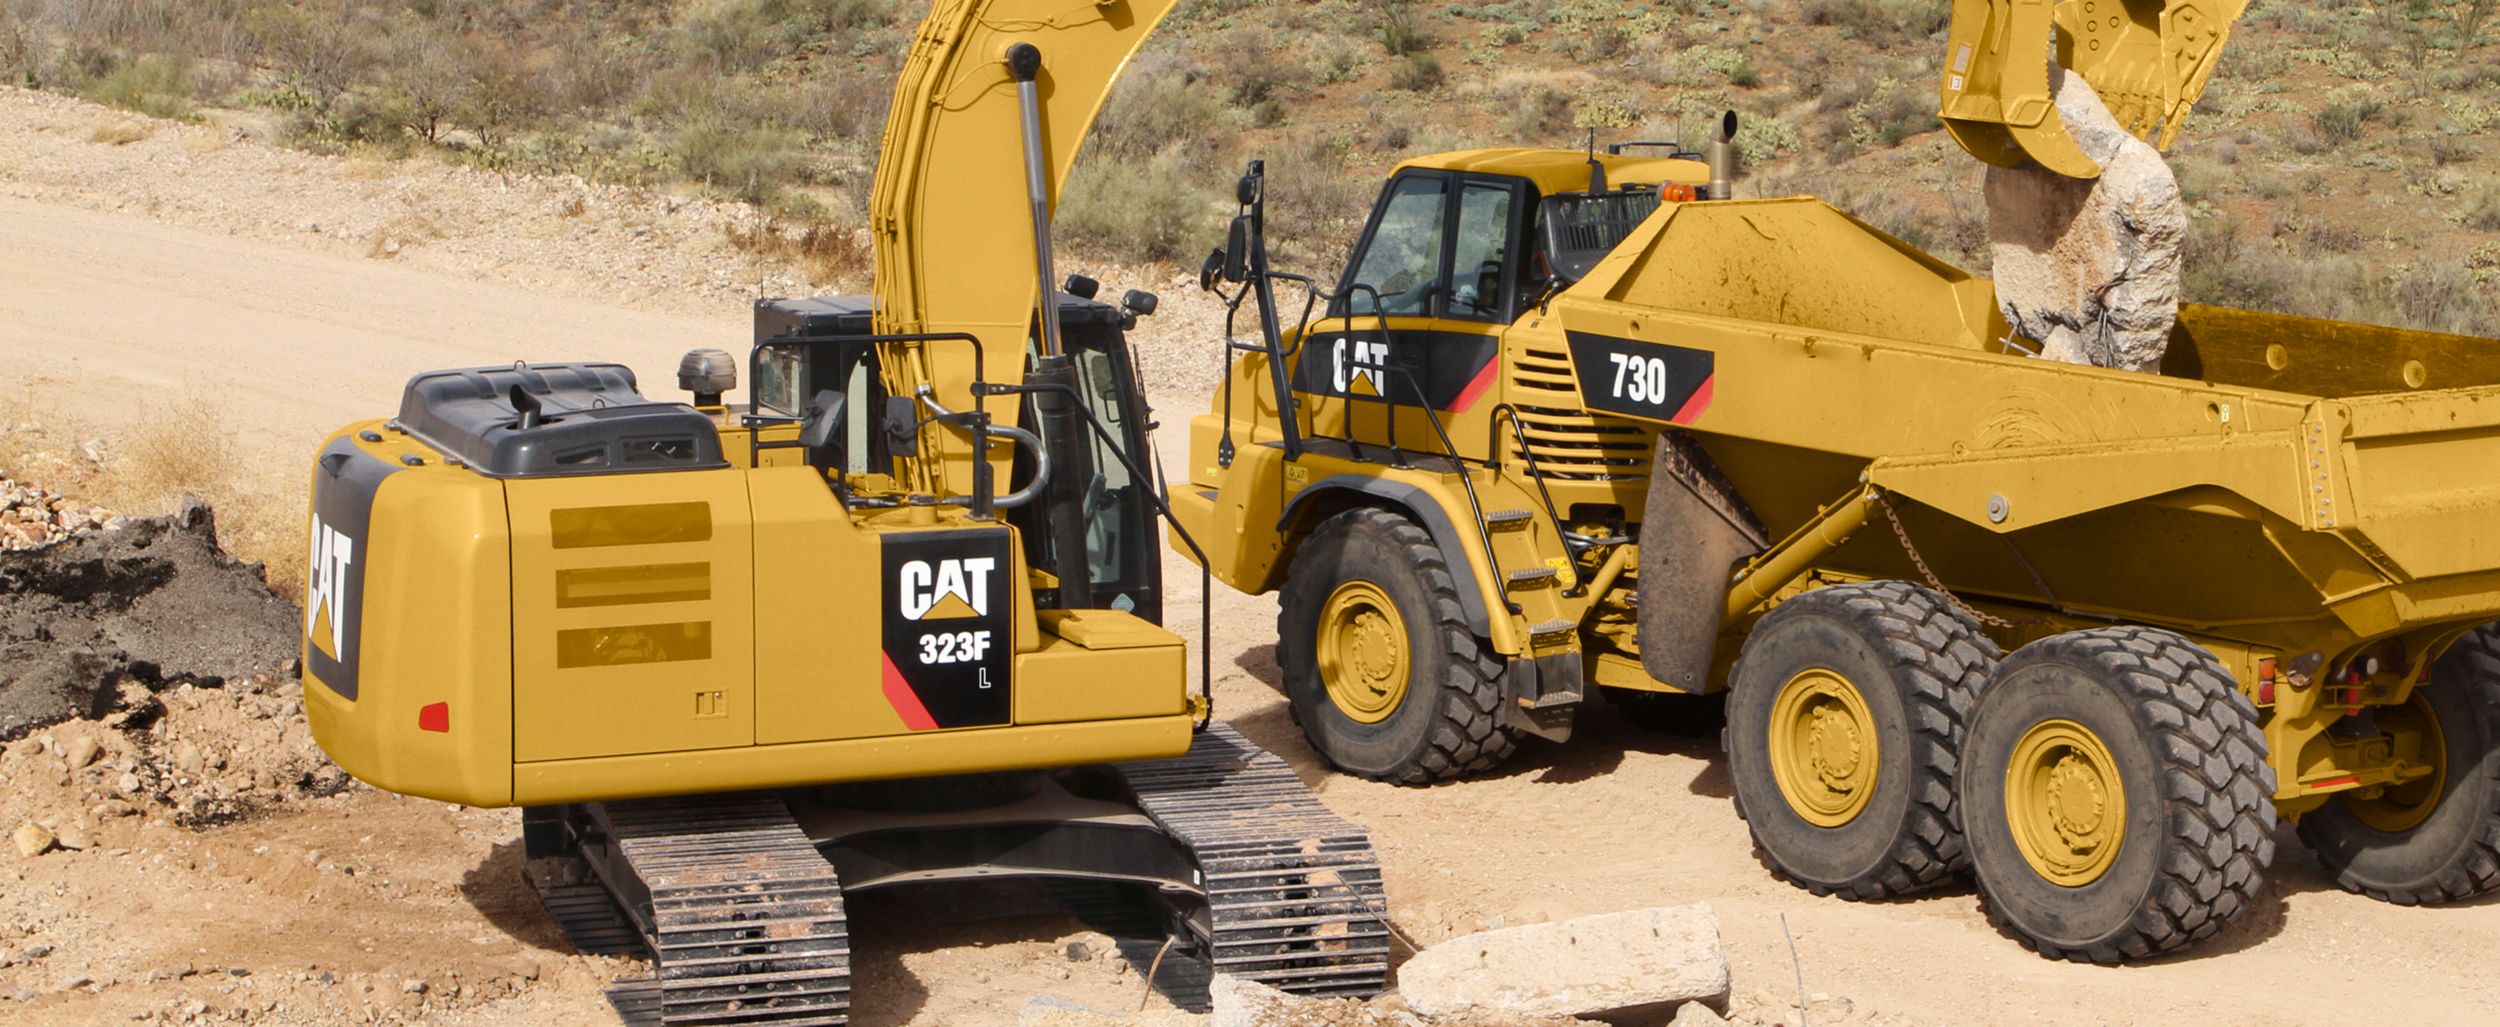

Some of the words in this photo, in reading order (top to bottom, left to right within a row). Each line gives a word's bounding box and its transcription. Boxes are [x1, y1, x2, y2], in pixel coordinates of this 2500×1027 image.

[1333, 337, 1389, 397] CAT
[1609, 352, 1666, 405] 730
[308, 512, 352, 663] CAT
[900, 557, 995, 621] CAT
[919, 630, 991, 664] 323F
[979, 667, 991, 689] L
